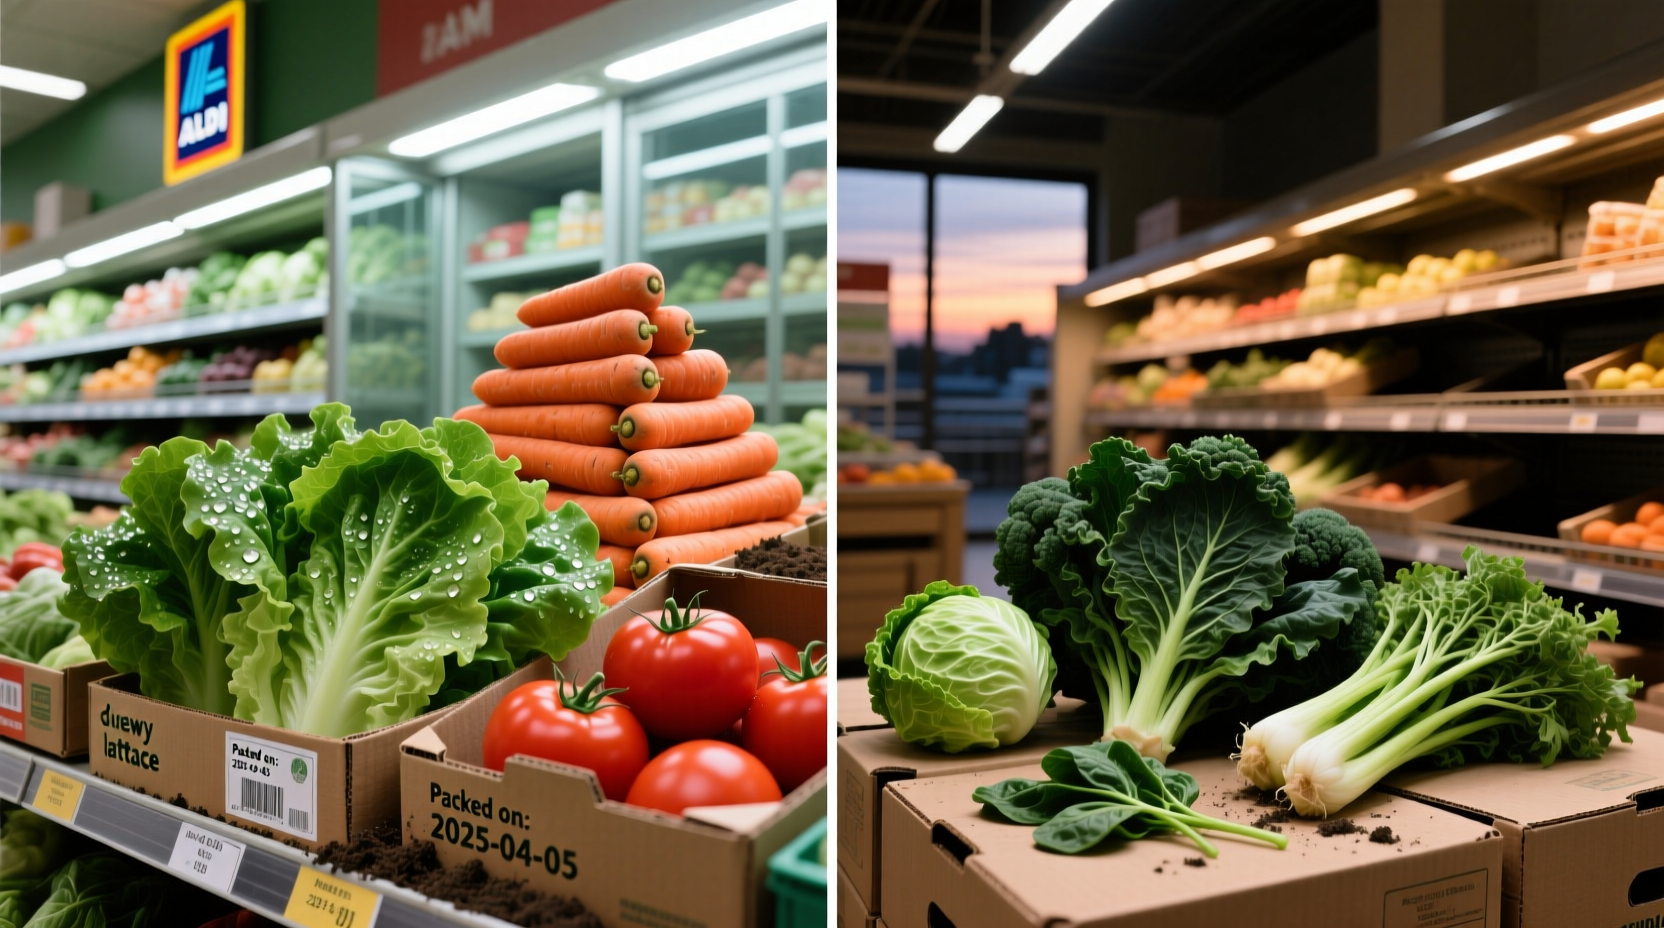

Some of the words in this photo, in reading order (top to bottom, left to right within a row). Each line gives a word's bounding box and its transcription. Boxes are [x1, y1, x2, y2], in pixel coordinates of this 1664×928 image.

[178, 101, 229, 148] ALDI
[104, 731, 160, 772] lattace
[430, 781, 493, 820] Packed
[498, 806, 530, 830] on:
[431, 812, 578, 880] 2025-04-05
